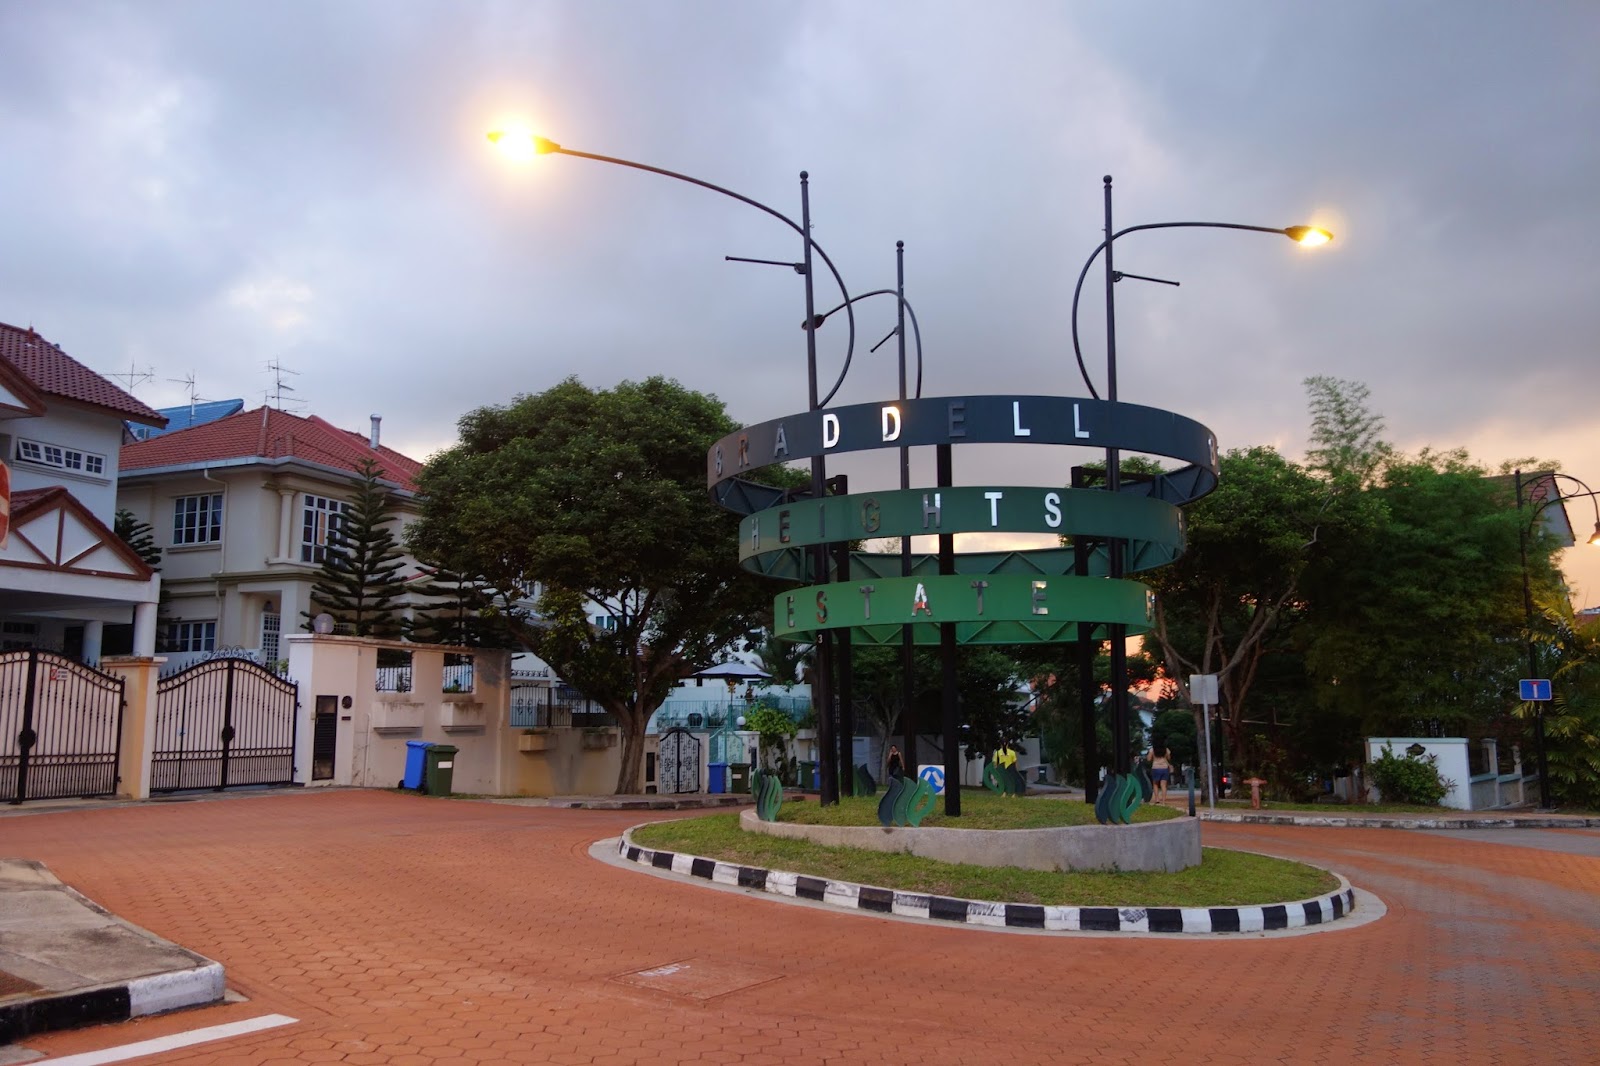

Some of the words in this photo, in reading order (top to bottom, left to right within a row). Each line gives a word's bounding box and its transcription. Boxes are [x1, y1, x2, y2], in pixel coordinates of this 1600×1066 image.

[715, 400, 1090, 478] BRADDELL
[751, 491, 1062, 551] HEIGHTS
[786, 580, 1049, 627] ESTATE
